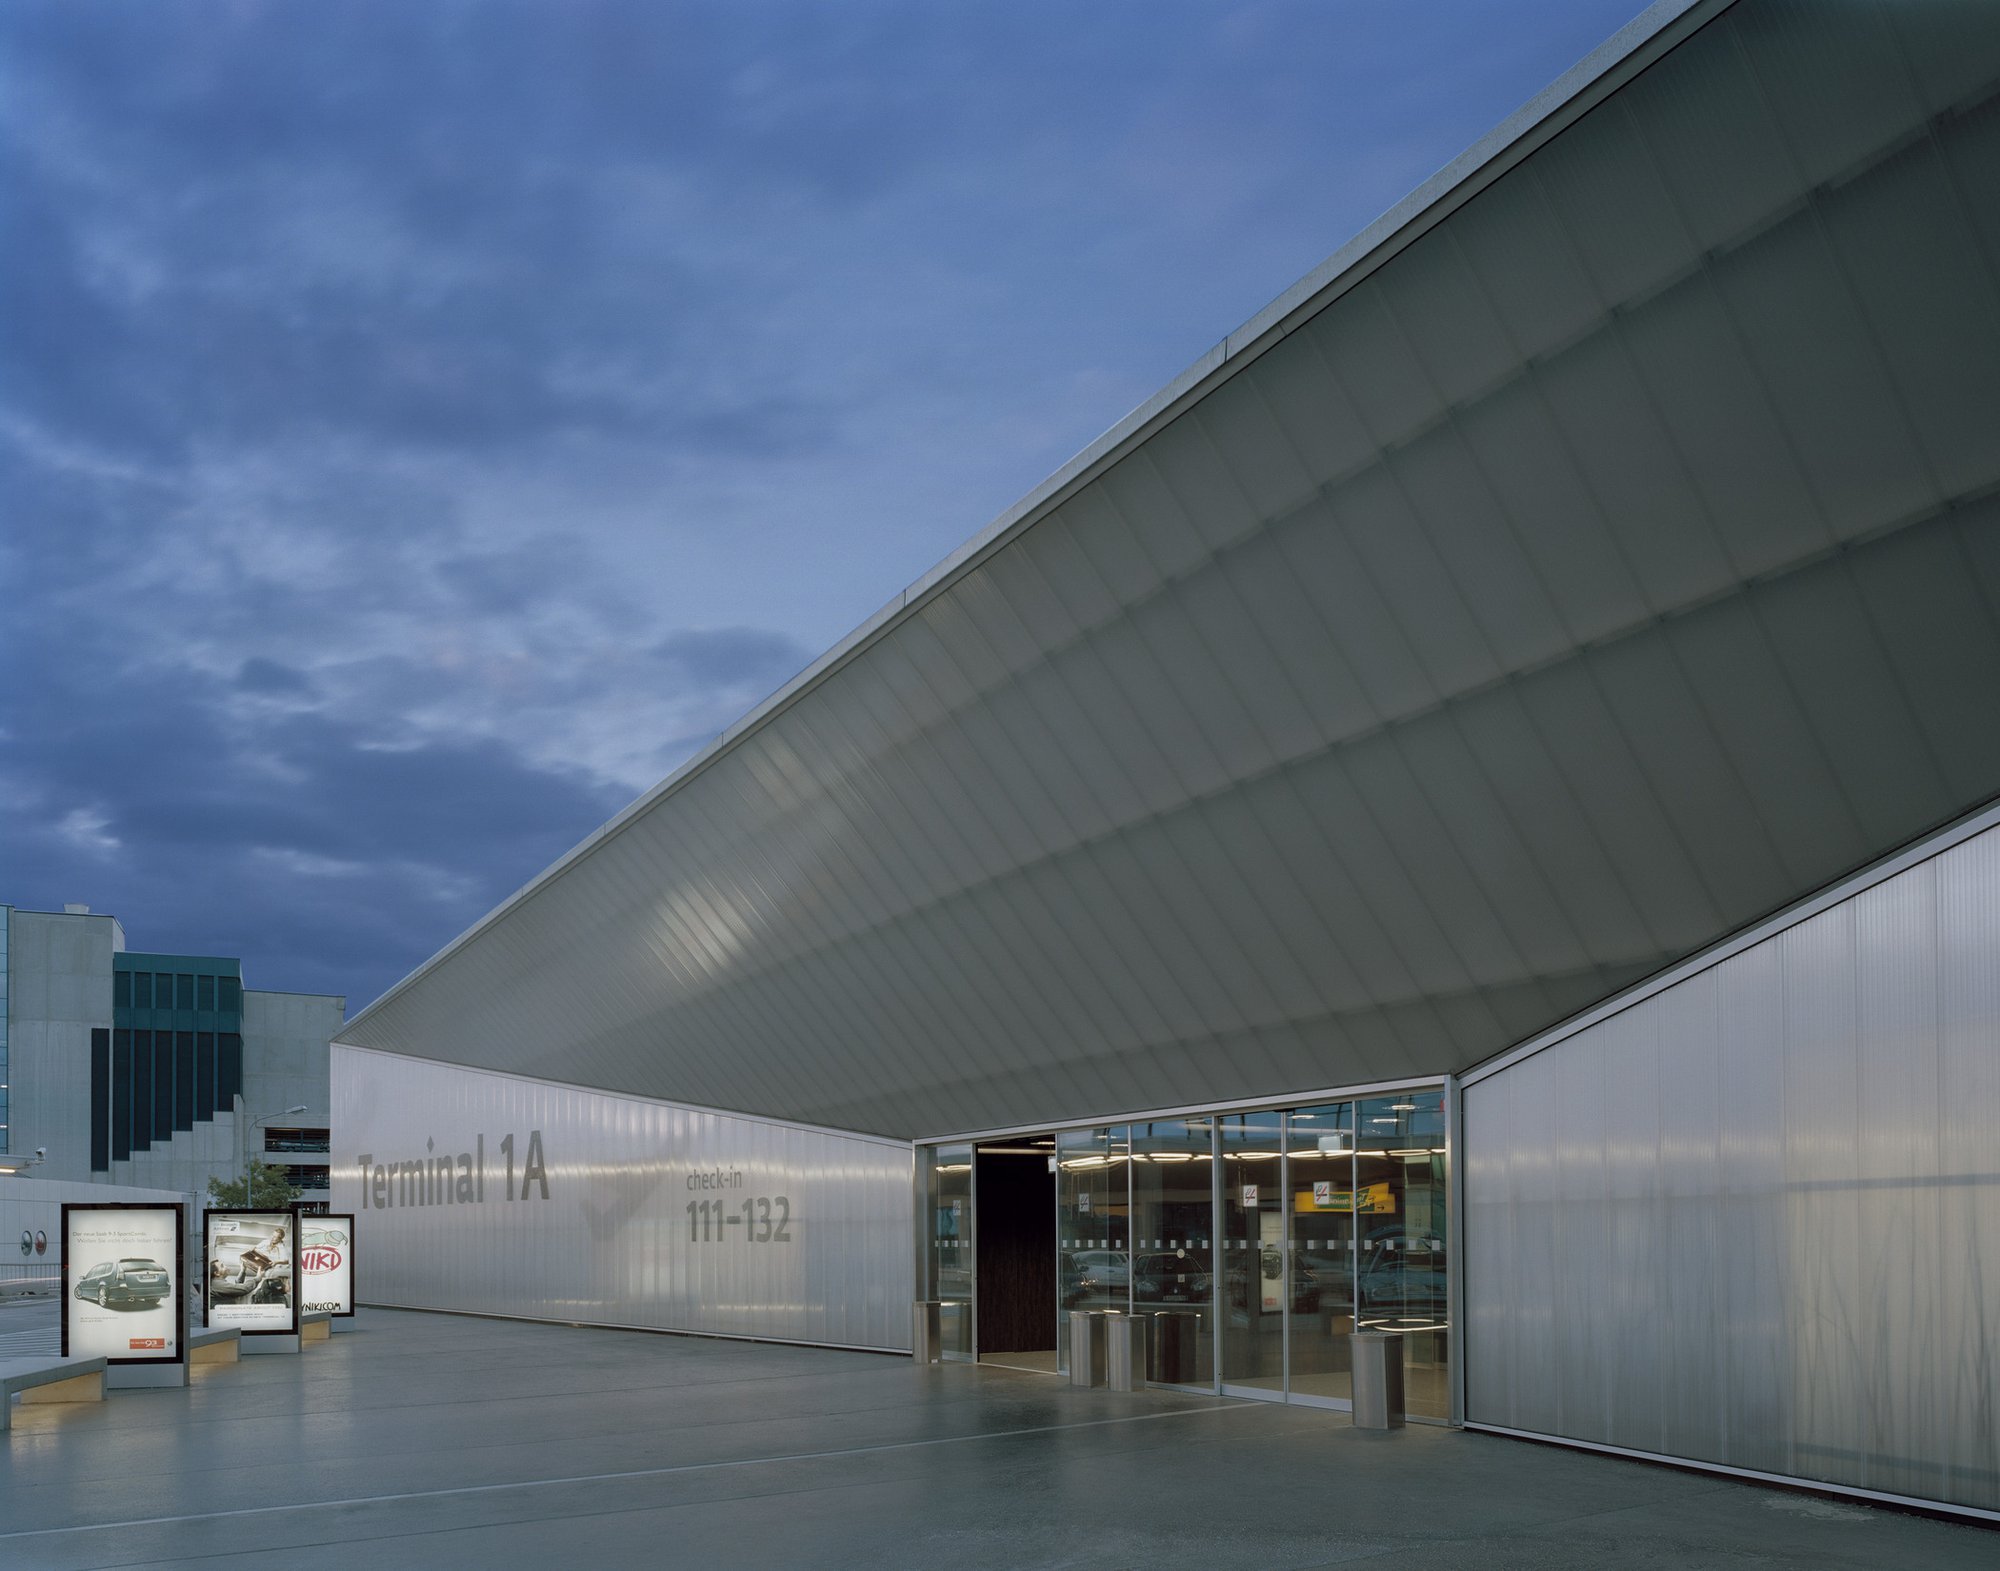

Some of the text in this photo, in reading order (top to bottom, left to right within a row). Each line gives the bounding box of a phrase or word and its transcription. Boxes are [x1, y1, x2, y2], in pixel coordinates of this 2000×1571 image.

[358, 1130, 550, 1209] Terminal 1A
[686, 1165, 742, 1191] check-in
[686, 1196, 791, 1243] 111-132
